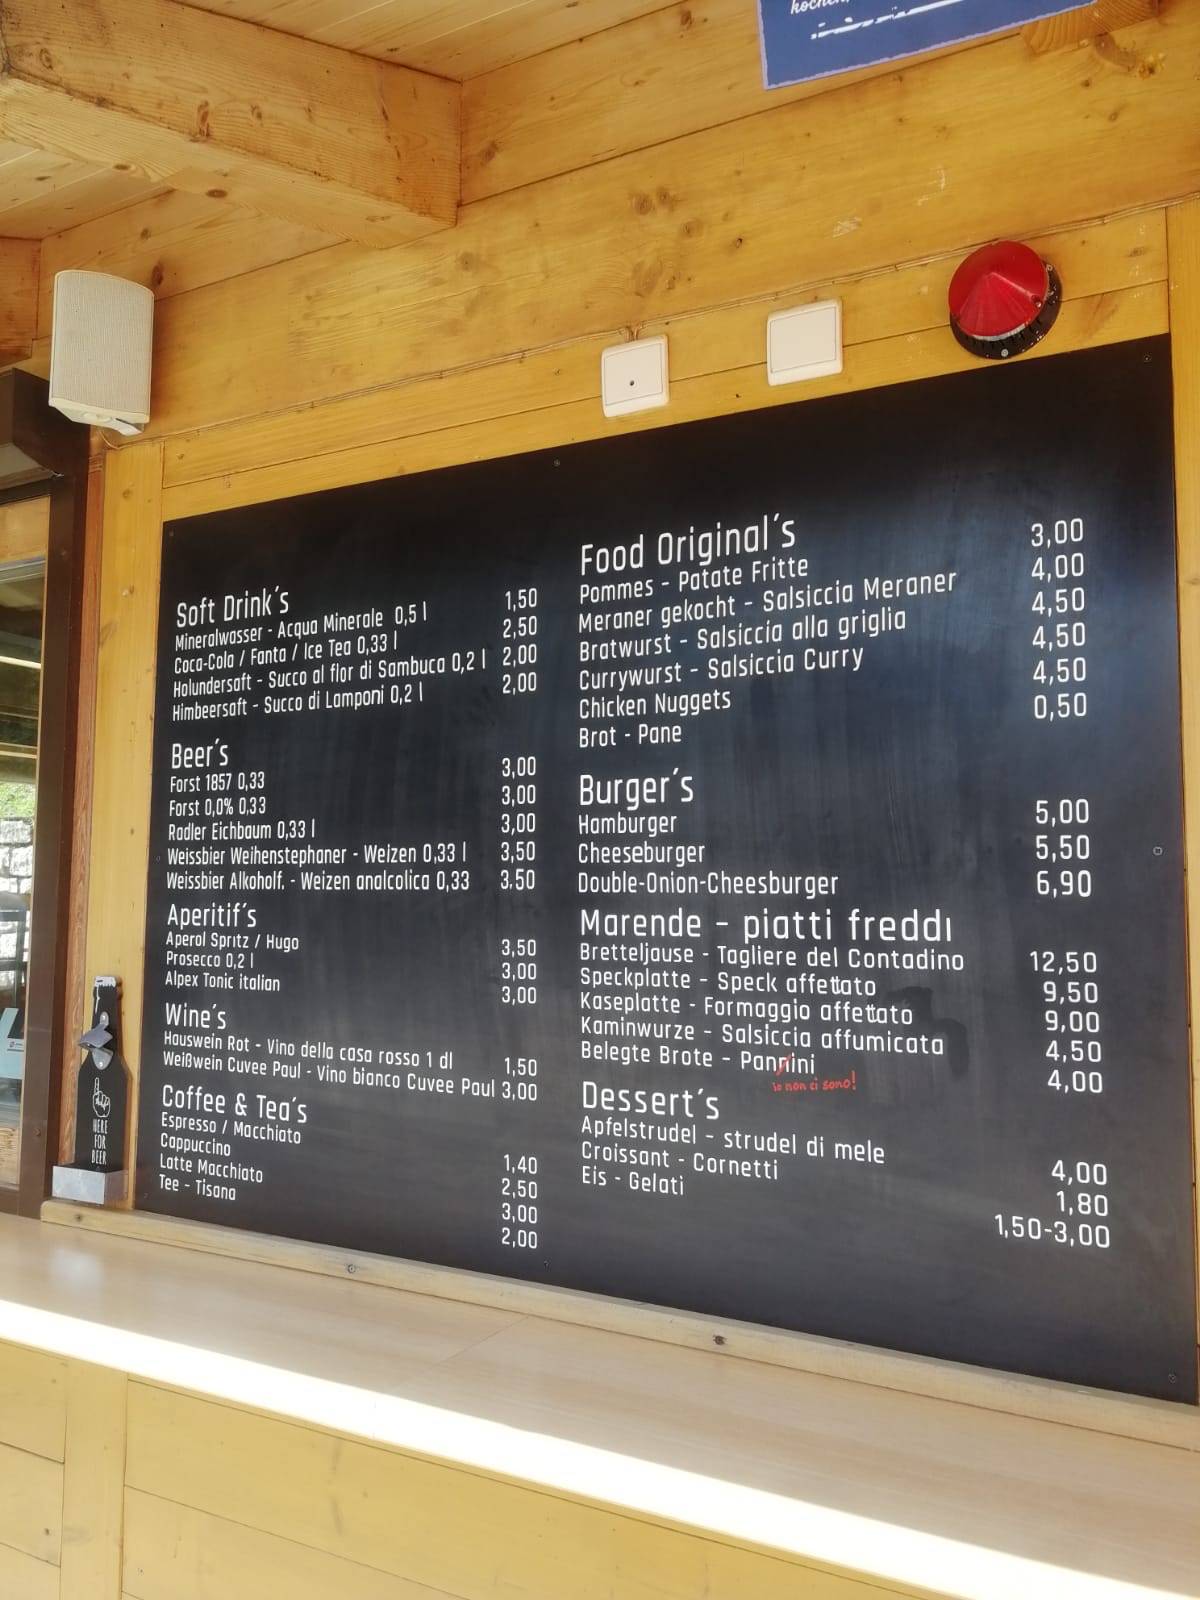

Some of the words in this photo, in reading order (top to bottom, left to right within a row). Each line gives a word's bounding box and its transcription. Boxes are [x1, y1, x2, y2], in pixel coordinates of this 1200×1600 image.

[1031, 518, 1084, 549] 3,00
[581, 534, 644, 576] Food
[1031, 552, 1084, 583] 4,00
[580, 579, 654, 605] Pommes
[679, 566, 743, 593] Patate
[752, 556, 808, 583] Fritte
[176, 596, 216, 628] Soft
[505, 587, 538, 613] 1,50
[579, 609, 653, 634] Meraner
[661, 595, 736, 629] gekocht
[763, 579, 853, 612] Salsiccia
[864, 572, 957, 601] Meraner
[1032, 587, 1085, 618] 4,50
[175, 627, 263, 652] Mineralwasser
[277, 619, 318, 640] Acqua
[323, 608, 383, 633] Minerale
[395, 604, 417, 627] 0,5
[503, 615, 538, 640] 2,50
[580, 633, 672, 662] Bratwurst
[697, 619, 783, 650] Salsiccia
[792, 614, 828, 641] alla
[838, 606, 906, 641] griglia
[174, 650, 235, 675] Coca-Cola
[251, 646, 287, 666] Fanta
[304, 642, 323, 660] Ice
[328, 638, 352, 658] Tea
[357, 633, 388, 656] 0,33
[502, 643, 537, 668] 2,00
[173, 672, 252, 699] Holundersaft
[268, 670, 307, 689] Succo
[378, 655, 446, 679] Sambuca
[452, 651, 475, 675] 0,2
[579, 662, 682, 692] Currywurst
[804, 647, 864, 672] Curry
[172, 697, 248, 722] Himbeersaft
[325, 684, 385, 711] Lamponi
[390, 683, 413, 706] 0,2
[579, 694, 647, 720] Chicken
[655, 689, 731, 717] Nuggets
[1034, 692, 1087, 722] 0,50
[579, 726, 617, 748] Brot
[638, 723, 682, 745] Pane
[502, 756, 537, 780] 3,00
[170, 775, 201, 793] Forst
[205, 772, 233, 792] 1857
[238, 771, 265, 792] 0,33
[169, 799, 200, 817] Forst
[204, 797, 234, 818] 0,0%
[1036, 798, 1089, 828] 5,00
[168, 822, 207, 841] Radler
[211, 820, 272, 841] Eichbaum
[277, 820, 306, 841] 0,33
[578, 811, 678, 838] Hamburger
[167, 846, 226, 866] Weissbier
[230, 844, 347, 868] Weihenstephaner
[364, 843, 417, 864] Weizen
[423, 843, 456, 865] 0,33
[501, 841, 536, 864] 3,50
[578, 840, 706, 868] Cheeseburger
[1036, 834, 1090, 863] 5,50
[167, 870, 225, 890] Weissbier
[229, 870, 285, 890] Alkoholf.
[356, 869, 430, 891] analcolica
[436, 870, 470, 893] 0,33
[500, 868, 535, 891] 3,50
[578, 870, 839, 900] Double-Onion-Cheesburger
[1037, 870, 1092, 899] 6,90
[581, 907, 701, 938] Marende
[744, 907, 832, 945] piatti
[165, 931, 206, 949] Aperol
[266, 934, 299, 953] Hugo
[501, 938, 537, 958] 3,50
[166, 950, 221, 968] Prosecco
[226, 953, 245, 970] 0,2
[580, 942, 694, 966] Bretteljause
[717, 944, 797, 969] Tagliere
[807, 946, 838, 968] del
[848, 948, 964, 971] Contadino
[1030, 951, 1097, 975] 12,50
[165, 970, 199, 989] Alpex
[203, 972, 234, 990] Tonic
[239, 973, 280, 992] italian
[502, 962, 537, 982] 3,00
[580, 967, 691, 991] Speckplatte
[718, 971, 778, 995] Speck
[786, 972, 876, 996] affettato
[1043, 981, 1098, 1005] 9,50
[581, 991, 681, 1015] Kaseplatte
[704, 996, 810, 1024] Formaggio
[820, 1000, 913, 1025] affettato
[1045, 1010, 1100, 1033] 9,00
[164, 1030, 223, 1050] Hauswein
[227, 1035, 250, 1053] Rot
[267, 1038, 295, 1057] Vino
[301, 1041, 334, 1060] della
[340, 1047, 372, 1063] casa
[379, 1051, 420, 1067] rosso
[581, 1016, 695, 1041] Kaminwurze
[722, 1023, 811, 1048] Salsiccia
[821, 1028, 944, 1055] affumicata
[581, 1040, 651, 1066] Belegte
[659, 1045, 713, 1068] Brote
[1045, 1040, 1102, 1063] 4,50
[163, 1050, 223, 1071] Weißwein
[227, 1056, 267, 1076] Cuvee
[273, 1060, 301, 1079] Paul
[317, 1064, 347, 1083] Vino
[353, 1067, 401, 1089] bianco
[504, 1057, 537, 1077] 1,50
[784, 1082, 807, 1091] non
[822, 1070, 856, 1091] sono!
[502, 1081, 537, 1101] 3,00
[1047, 1069, 1103, 1094] 4,00
[162, 1084, 226, 1114] Coffee
[235, 1092, 248, 1117] &
[92, 1118, 108, 1135] HERE
[161, 1111, 217, 1134] Espresso
[234, 1121, 301, 1145] Macchiato
[581, 1115, 696, 1145] Apfelstrudel
[724, 1130, 796, 1155] strudel
[835, 1139, 885, 1164] mele
[94, 1134, 106, 1149] FOR
[160, 1132, 231, 1157] Cappuccino
[91, 1149, 107, 1165] BEER
[160, 1153, 193, 1173] Latte
[504, 1154, 538, 1175] 1,40
[582, 1141, 670, 1168] Croissant
[693, 1152, 778, 1180] Cornetti
[582, 1165, 607, 1186] Eis
[629, 1171, 684, 1196] Gelati
[1051, 1160, 1107, 1186] 4,00
[159, 1173, 180, 1192] Tee
[195, 1178, 236, 1201] Tisana
[502, 1177, 538, 1199] 2,50
[502, 1202, 538, 1224] 3,00
[1056, 1190, 1108, 1217] 1,80
[501, 1227, 538, 1249] 2,00
[995, 1214, 1110, 1249] 1,50-3,00
